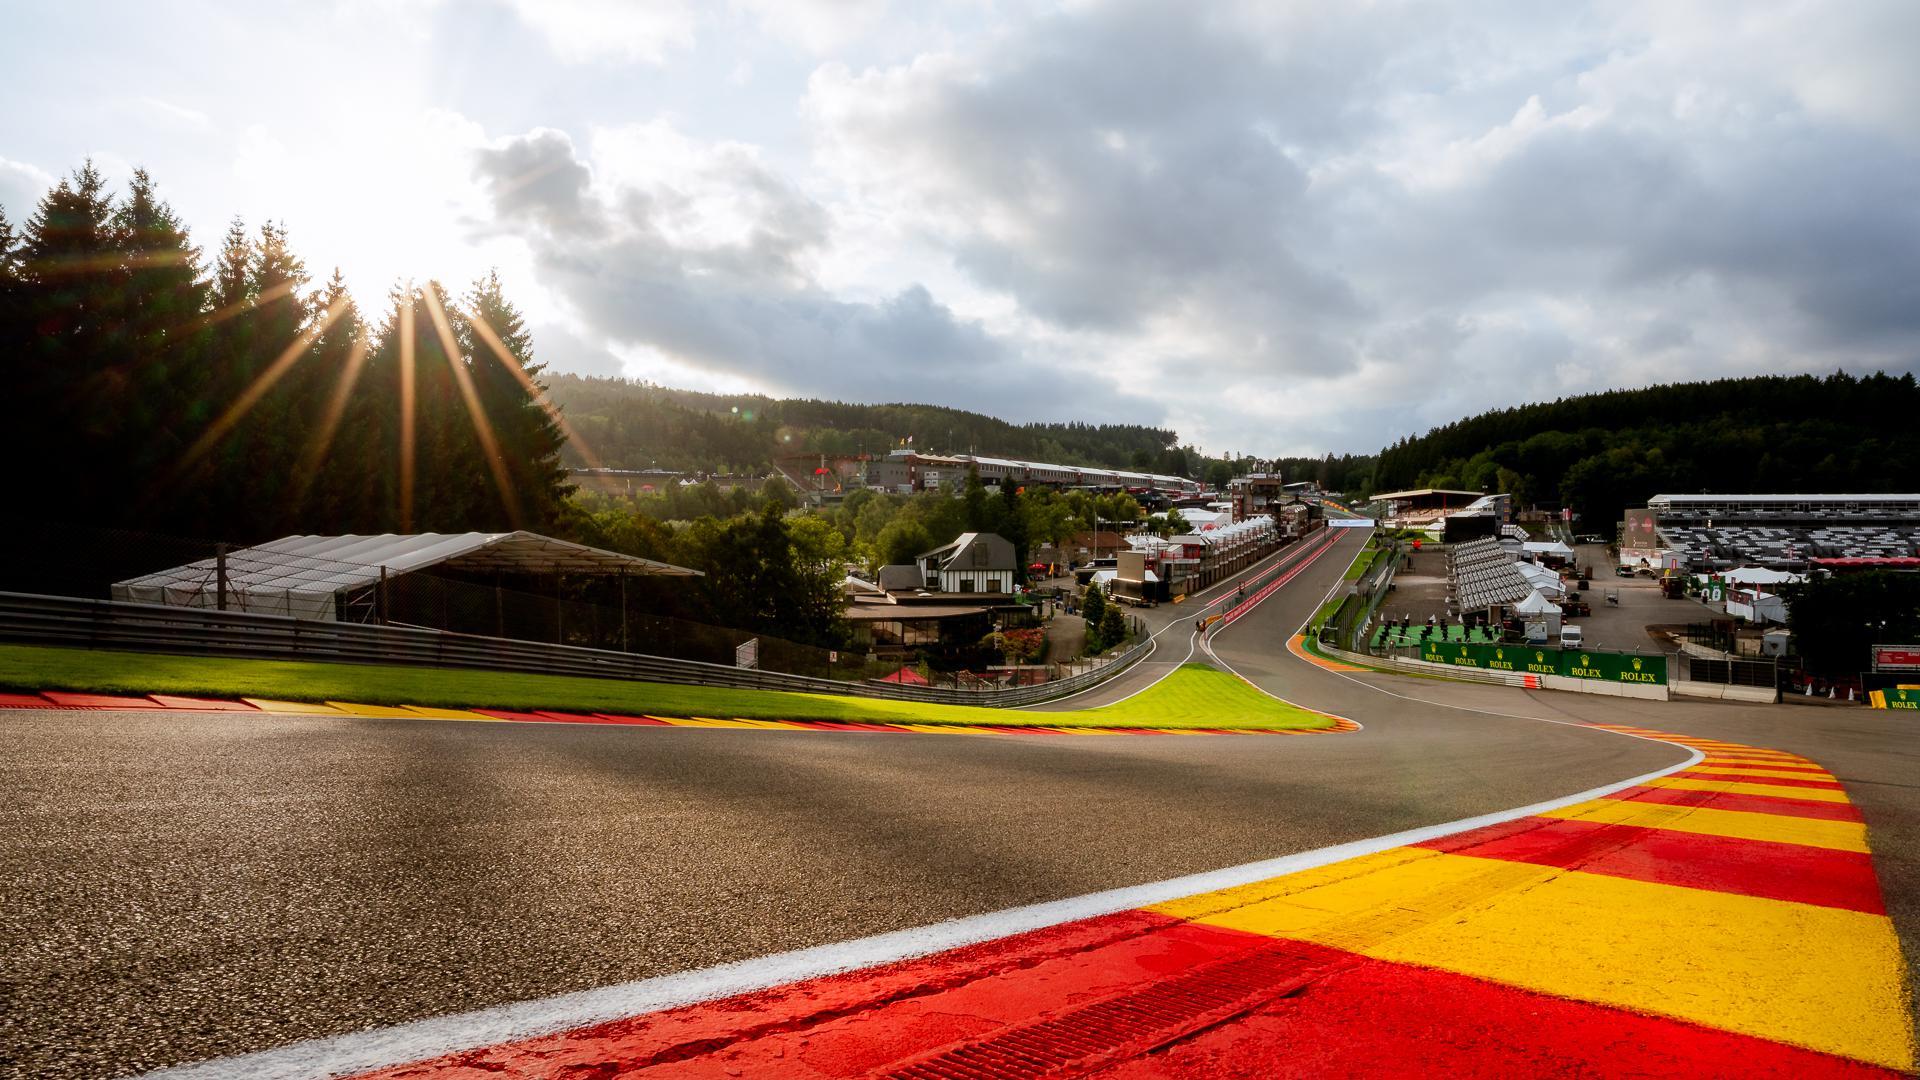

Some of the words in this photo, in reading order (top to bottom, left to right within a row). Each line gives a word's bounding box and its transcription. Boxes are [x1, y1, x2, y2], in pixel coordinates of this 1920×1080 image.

[1425, 653, 1444, 662] ROLEX
[1455, 657, 1477, 666] ROLEX
[1490, 661, 1512, 669] ROLEX
[1528, 663, 1555, 673] ROLEX
[1572, 667, 1602, 678] ROLEX
[1620, 672, 1656, 682] ROLEX
[1891, 701, 1918, 709] ROLEX
